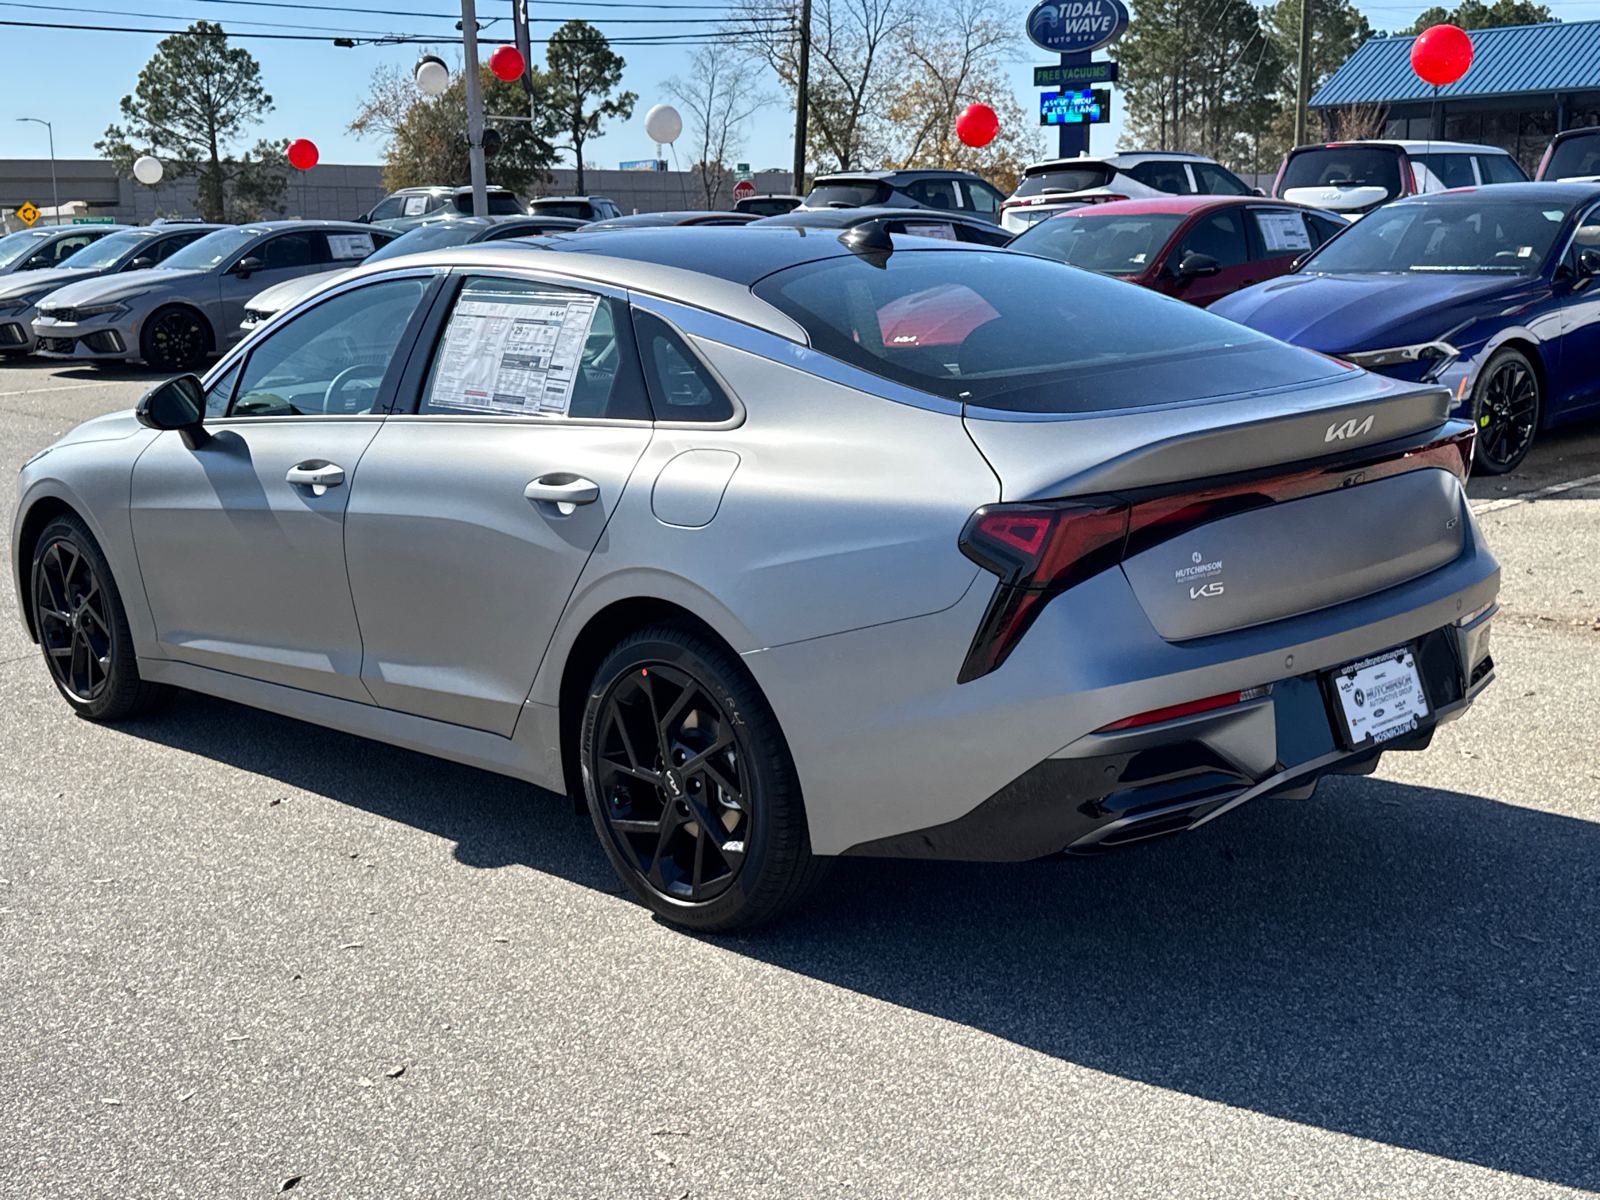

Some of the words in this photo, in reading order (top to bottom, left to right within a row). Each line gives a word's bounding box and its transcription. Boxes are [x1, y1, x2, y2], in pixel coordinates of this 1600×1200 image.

[1059, 1, 1102, 18] TIDAL
[1065, 16, 1111, 34] WAVE
[1037, 70, 1060, 82] FREE
[1062, 66, 1106, 79] VACUUMS
[735, 190, 755, 200] STOP
[1324, 414, 1375, 443] KIA
[1175, 561, 1222, 578] HUTCHINSON
[1190, 582, 1224, 599] K5
[1366, 674, 1413, 700] HUTCHINSON
[1369, 691, 1399, 708] AUTOMOTIVE
[1398, 686, 1413, 698] GROUP
[1374, 721, 1411, 744] HUTCHINSON
